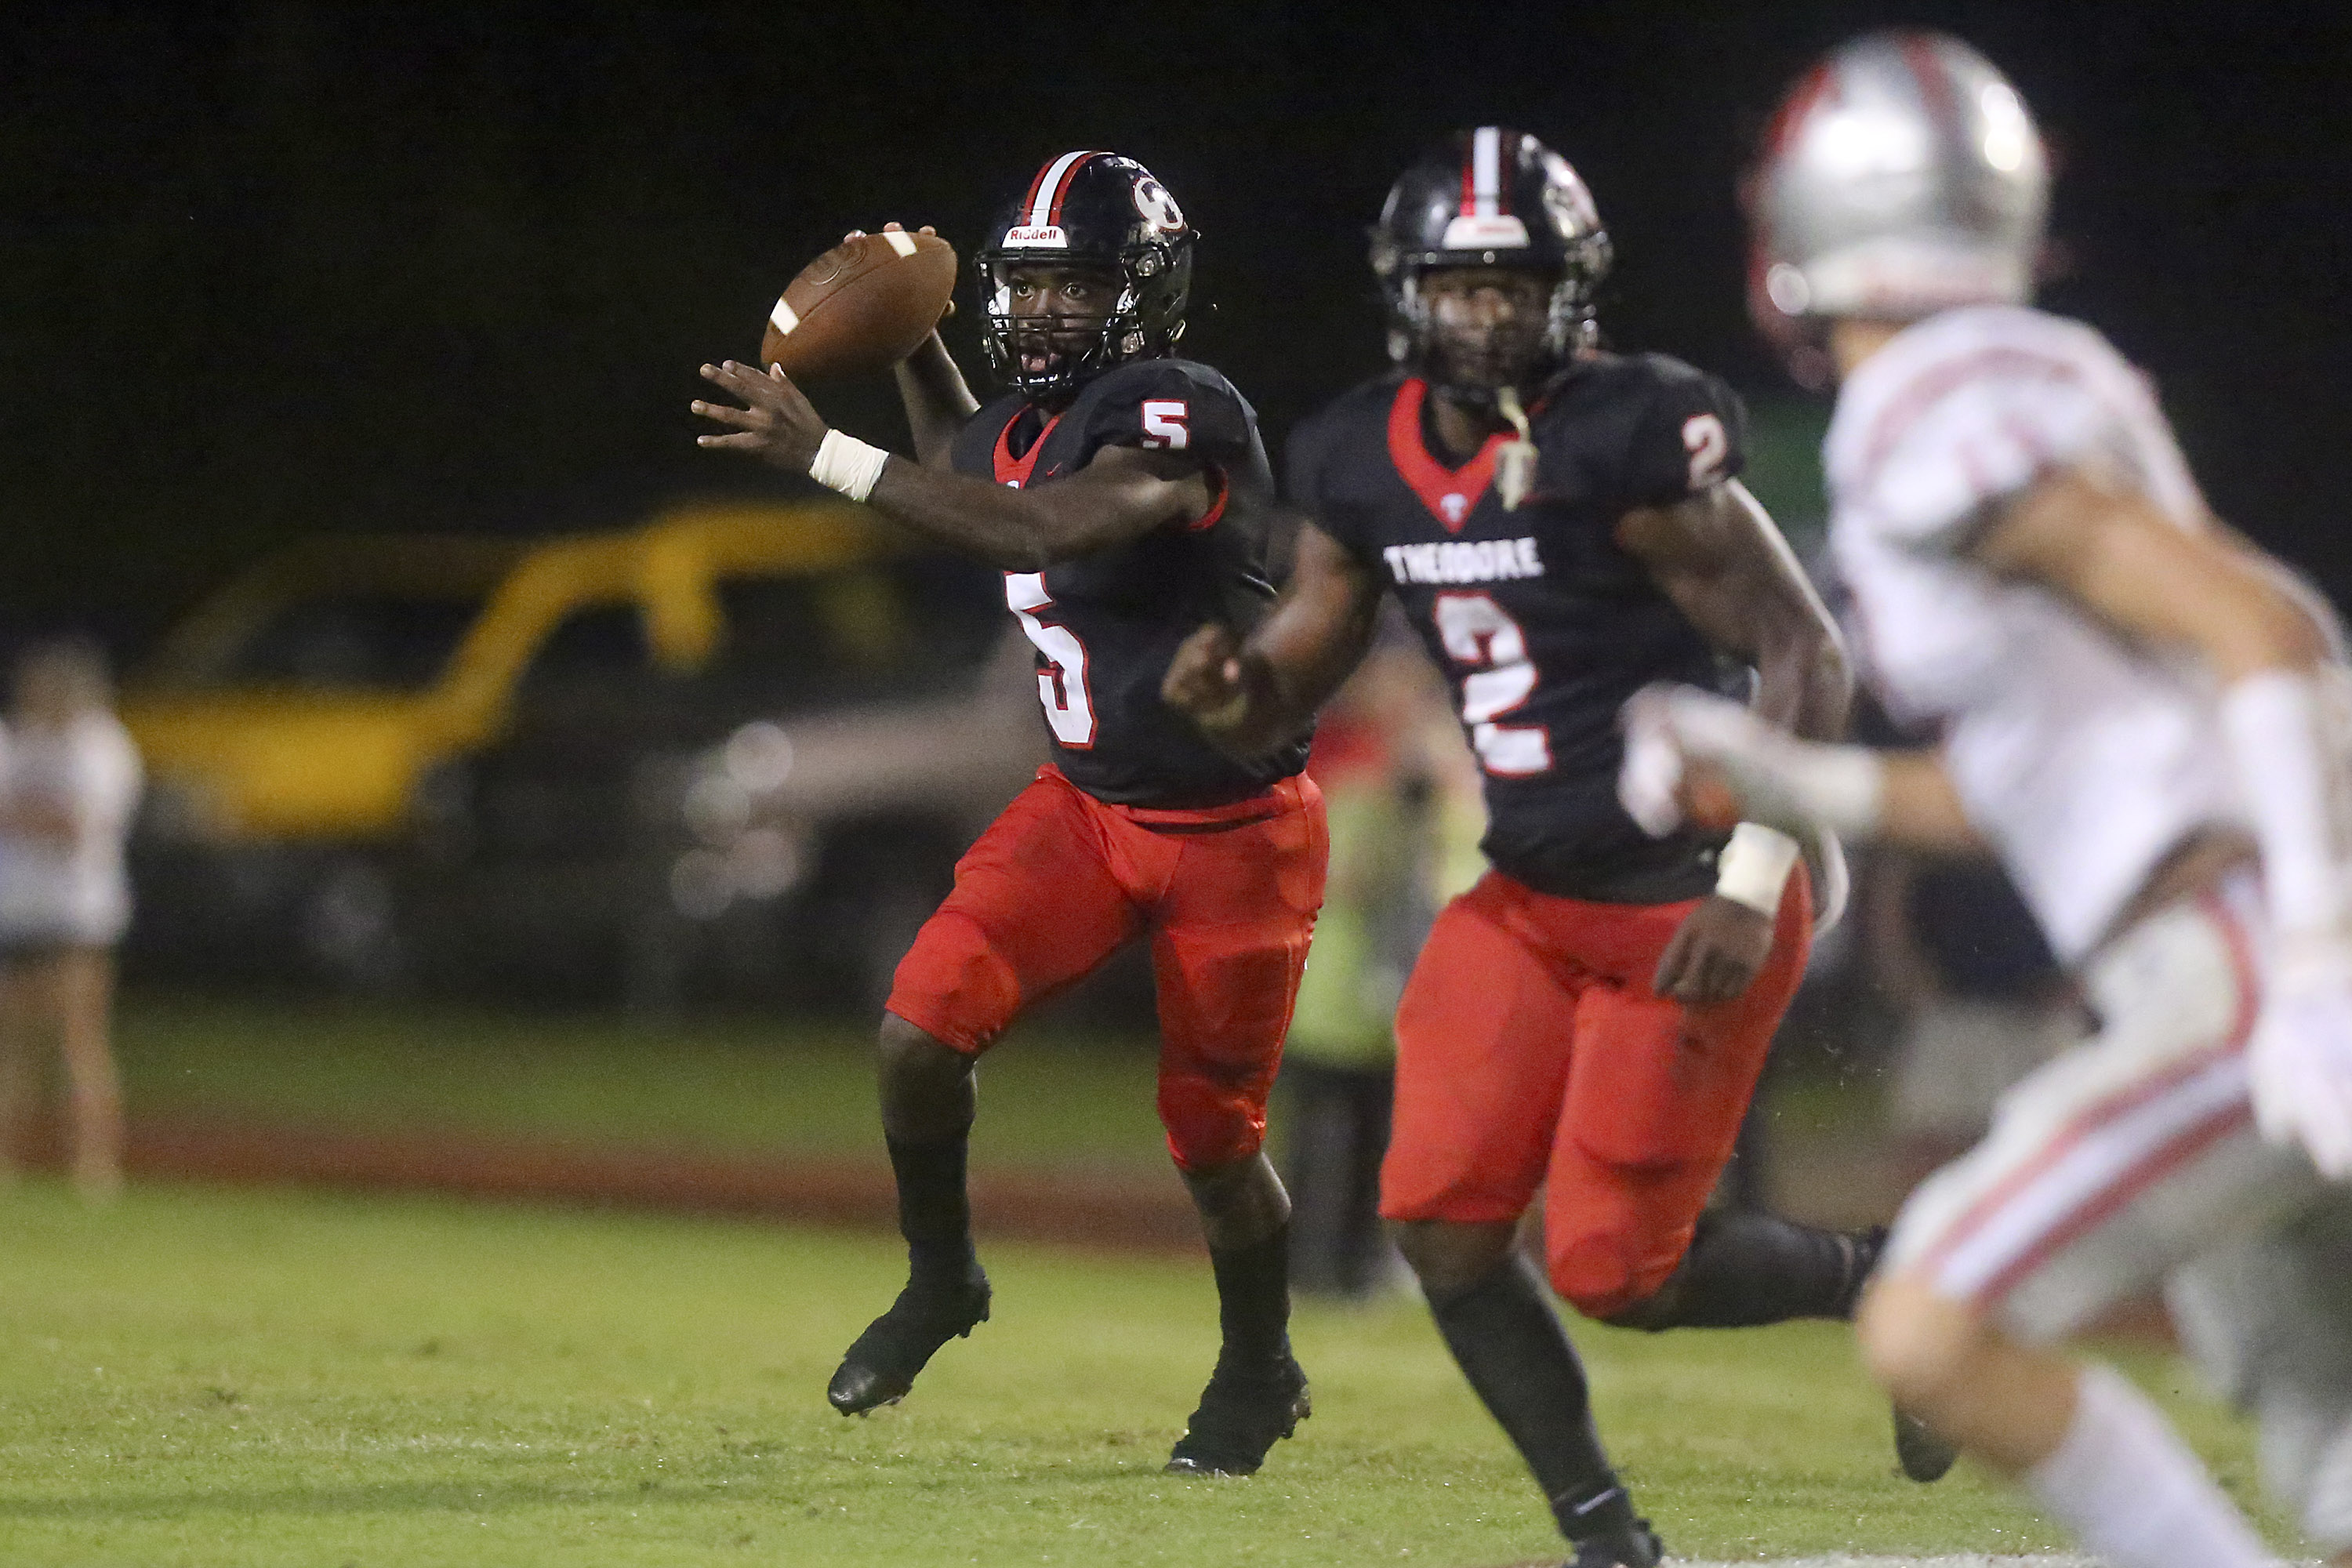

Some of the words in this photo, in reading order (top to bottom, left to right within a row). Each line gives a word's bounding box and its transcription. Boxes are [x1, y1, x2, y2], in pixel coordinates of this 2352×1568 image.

[1011, 229, 1057, 240] Riddell
[1142, 398, 1190, 449] 5
[1681, 412, 1726, 489] 2
[1382, 536, 1544, 584] THEODORE
[1003, 571, 1098, 750] 5
[1432, 590, 1555, 779] 2
